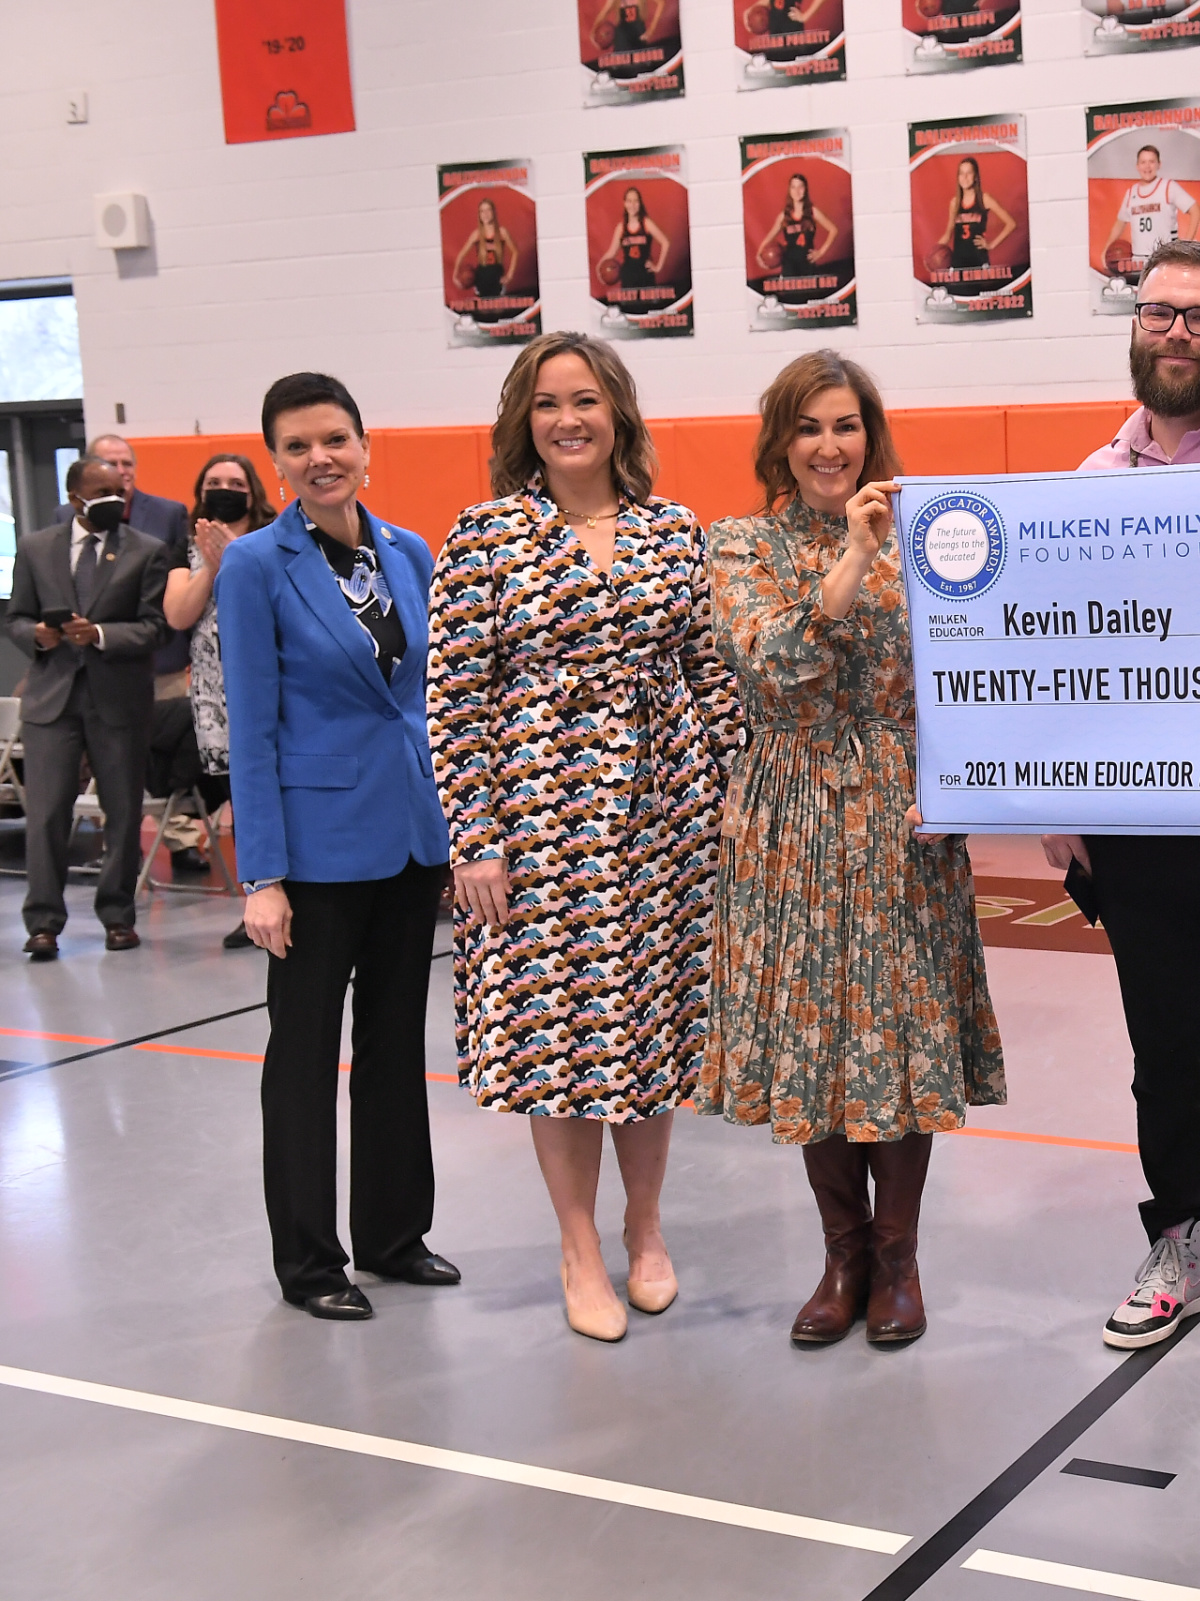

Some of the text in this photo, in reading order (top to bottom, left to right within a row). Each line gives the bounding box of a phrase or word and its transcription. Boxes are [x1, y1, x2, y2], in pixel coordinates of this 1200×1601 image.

[1139, 217, 1152, 233] 50
[968, 295, 1024, 311] 2021-2022
[914, 498, 1000, 576] MILKEN EDUCATOR AWARDS
[937, 527, 977, 538] The future
[1019, 518, 1110, 540] MILKEN
[929, 541, 959, 551] belongs
[971, 540, 985, 548] the
[939, 552, 976, 561] educated
[940, 580, 977, 593] Est. 1987
[928, 614, 967, 625] MILKEN
[1003, 599, 1172, 642] Kevin Dailey
[929, 627, 985, 638] EDUCATOR
[932, 667, 1110, 702] TWENTY-FIVE
[939, 774, 961, 786] FOR
[965, 761, 1006, 787] 2021
[1015, 761, 1088, 787] MILKEN
[1094, 761, 1193, 787] EDUCATOR
